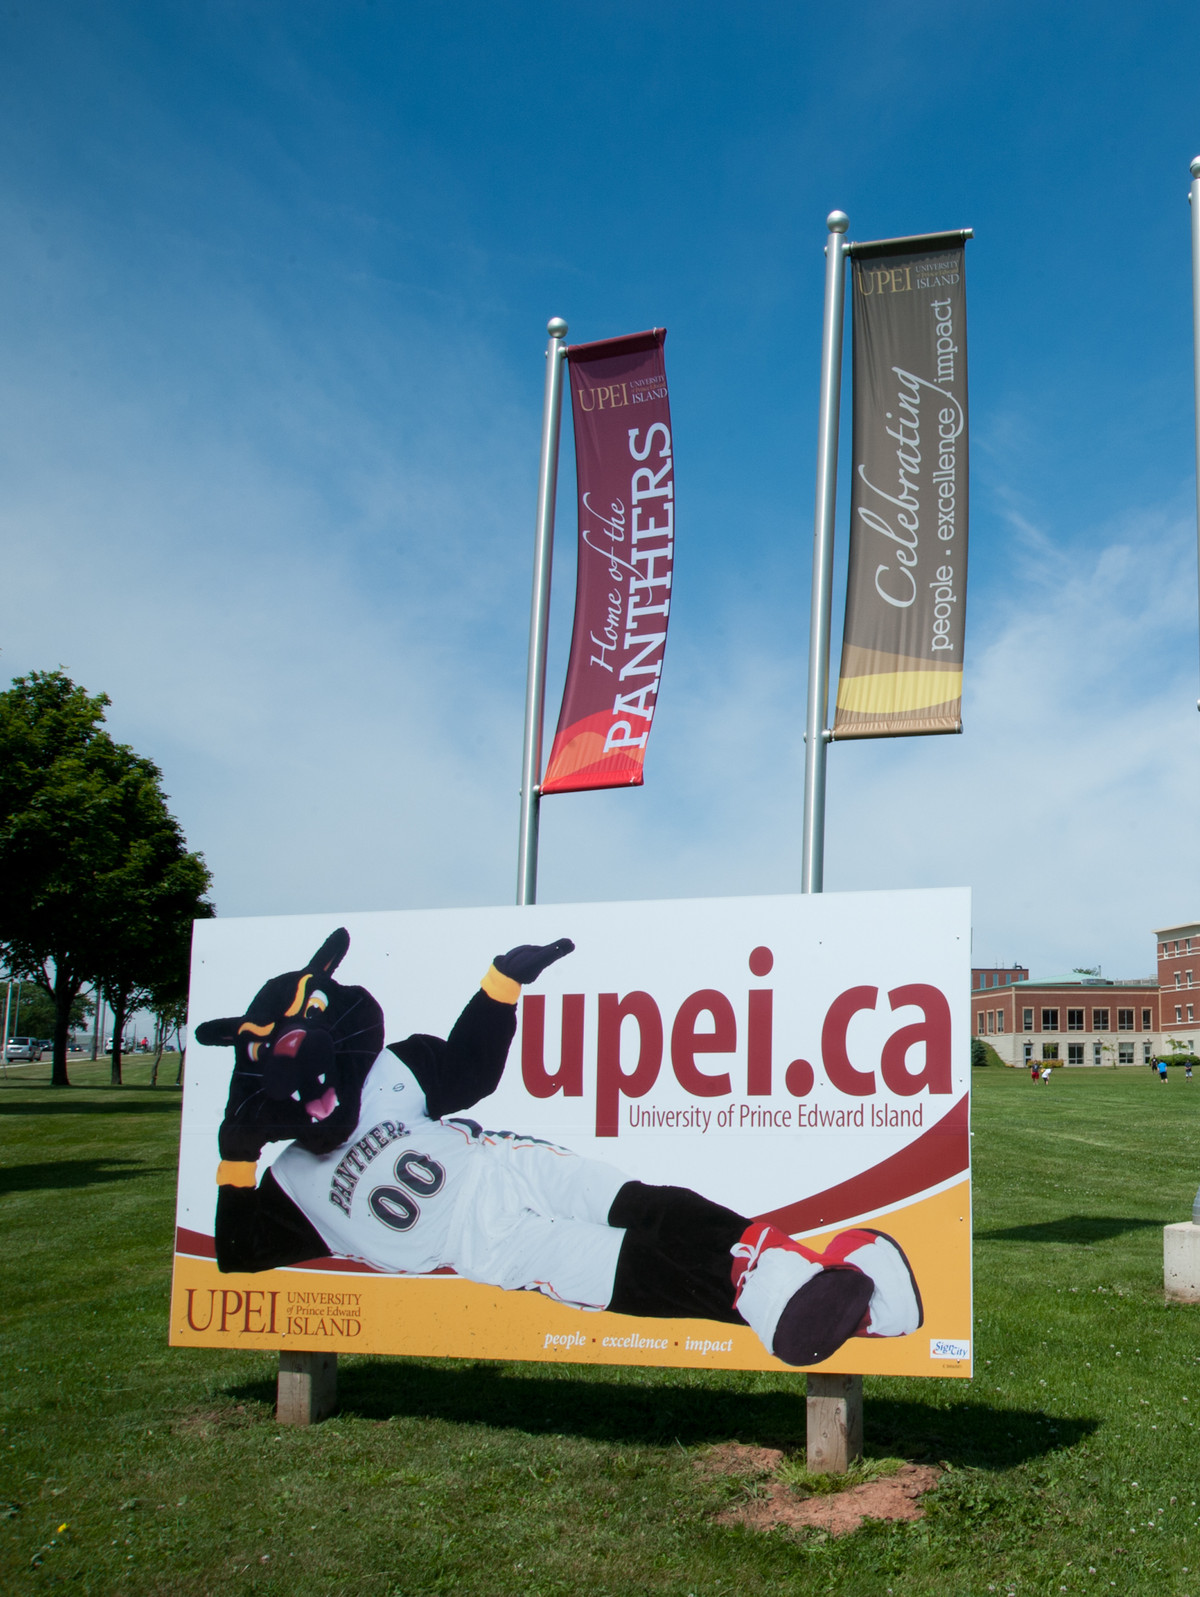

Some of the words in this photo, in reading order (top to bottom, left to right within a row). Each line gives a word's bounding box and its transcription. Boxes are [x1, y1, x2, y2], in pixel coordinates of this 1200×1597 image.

[858, 267, 913, 296] UPEI
[915, 260, 959, 273] UNIVERSITY
[916, 273, 960, 289] ISLAND
[930, 298, 958, 383] impact
[578, 383, 629, 412] UPEI
[631, 387, 668, 404] ISLAND
[858, 366, 965, 608] Celebrating
[933, 408, 957, 541] excellence
[583, 492, 626, 542] the
[583, 530, 653, 606] of
[603, 422, 674, 753] PANTHERS
[590, 588, 623, 673] Home
[929, 565, 957, 652] people
[521, 945, 953, 1137] upei.ca
[629, 1104, 712, 1134] University
[717, 1103, 735, 1128] of
[740, 1104, 792, 1128] Prince
[798, 1103, 864, 1127] Edward
[871, 1103, 923, 1127] Island
[368, 1149, 446, 1232] 00
[185, 1289, 280, 1334] UPEI
[286, 1291, 363, 1306] UNIVERSITY
[296, 1304, 325, 1316] Prince
[326, 1306, 361, 1317] Edward
[286, 1316, 361, 1336] ISLAND
[544, 1331, 586, 1350] people
[602, 1333, 669, 1349] excellence
[685, 1336, 733, 1355] impact
